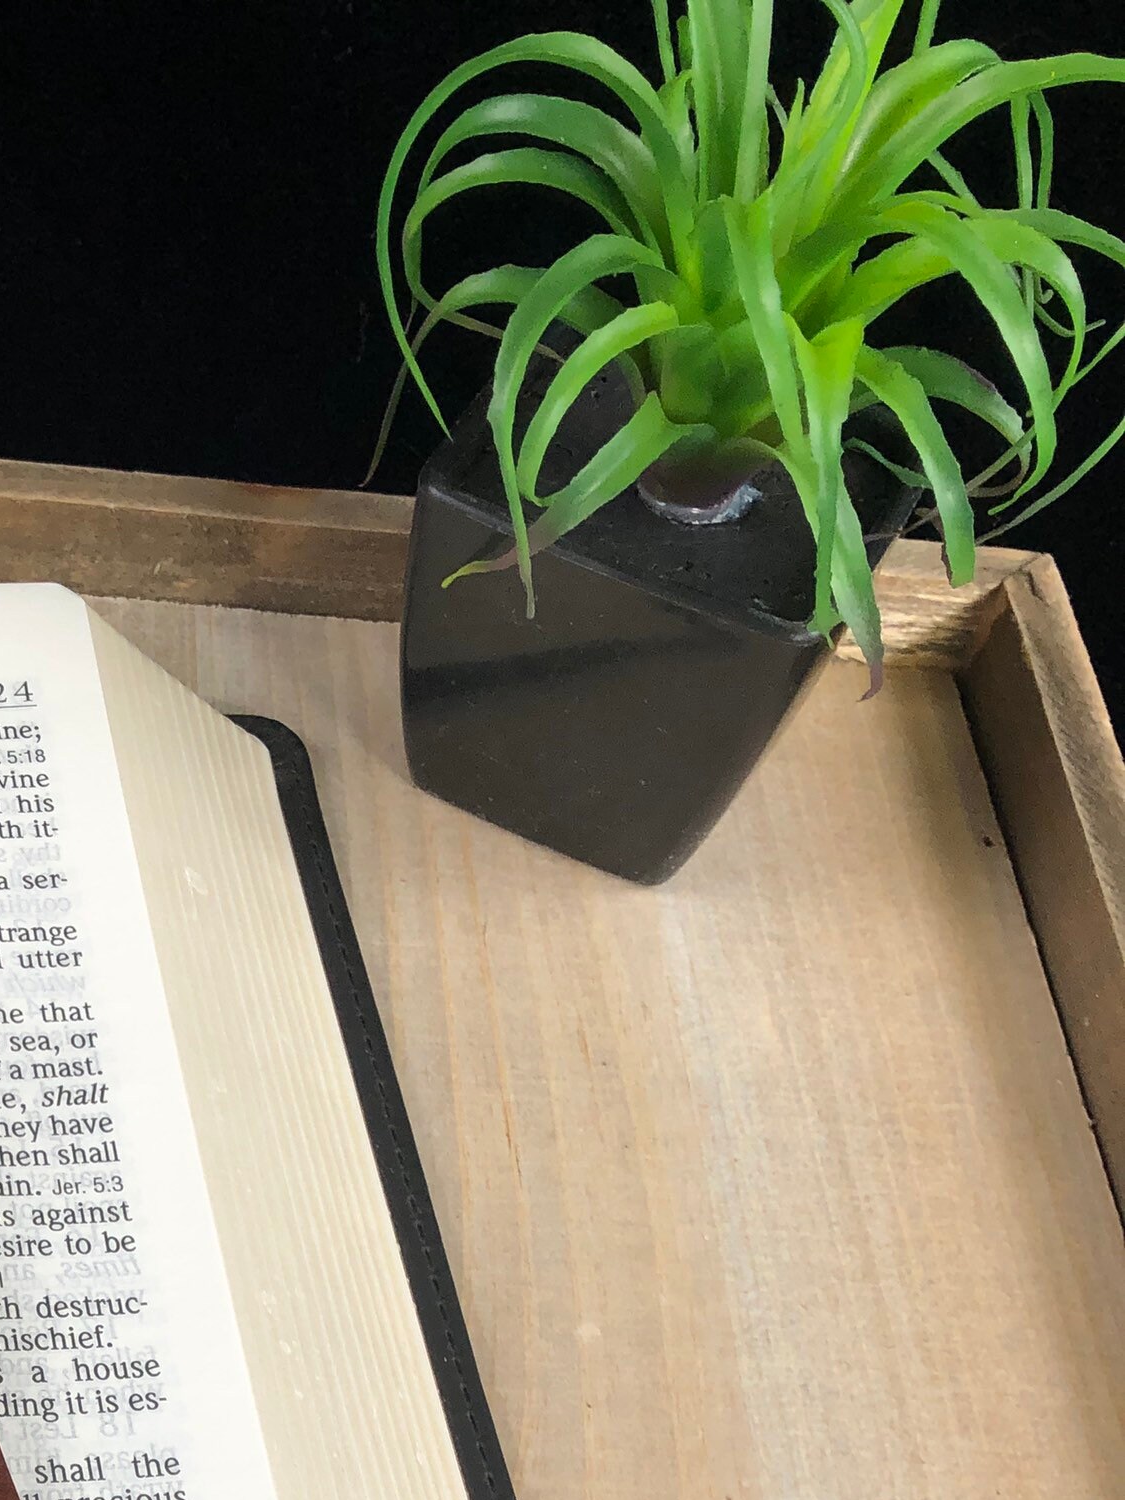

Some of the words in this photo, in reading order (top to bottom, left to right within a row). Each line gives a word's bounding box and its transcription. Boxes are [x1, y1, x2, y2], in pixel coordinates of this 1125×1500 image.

[6, 748, 46, 765] 5:18
[33, 820, 59, 838] it-
[21, 873, 68, 890] ser-
[9, 1034, 60, 1056] sea,
[70, 1032, 98, 1049] or
[49, 1114, 114, 1139] have
[51, 1178, 88, 1196] Jer.
[93, 1175, 124, 1194] 5:3
[31, 1200, 133, 1232] against
[35, 1294, 148, 1319] destruc-
[71, 1357, 161, 1382] house
